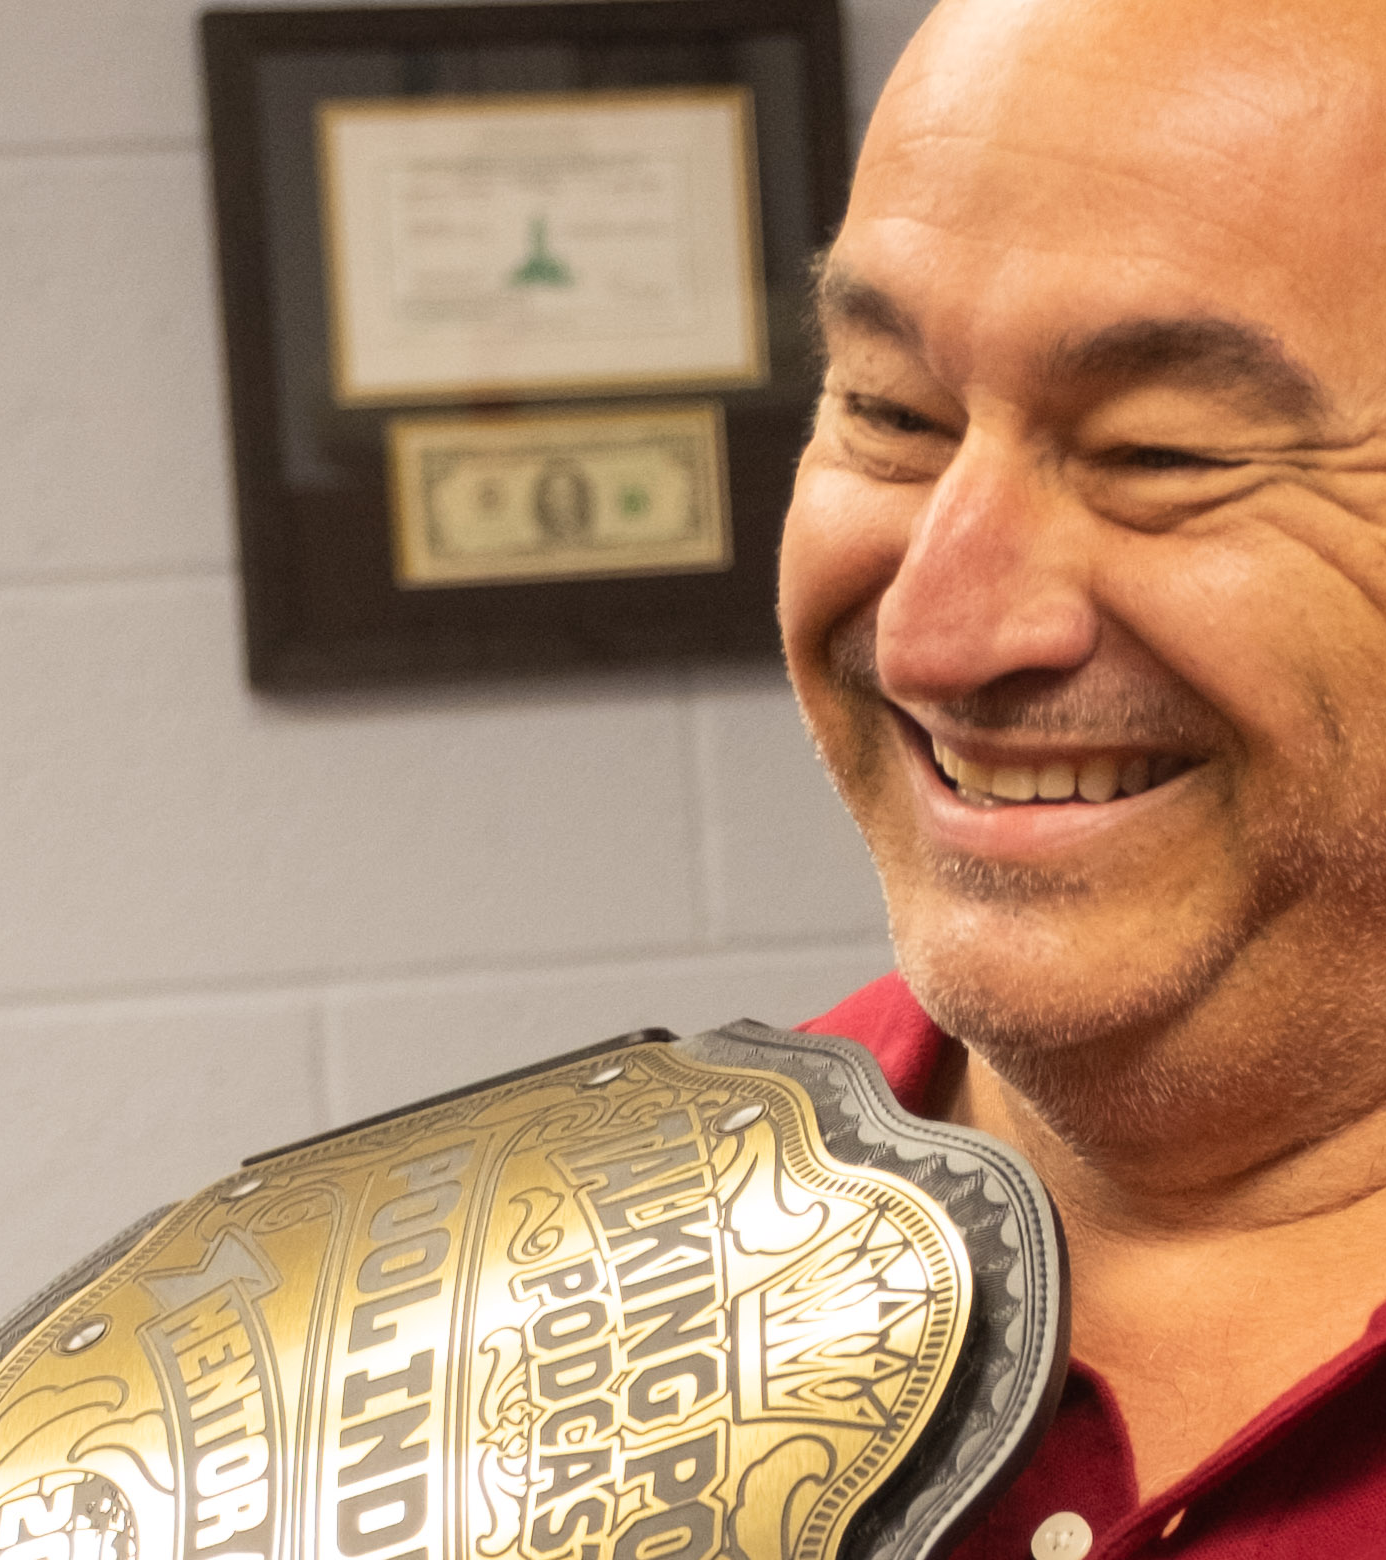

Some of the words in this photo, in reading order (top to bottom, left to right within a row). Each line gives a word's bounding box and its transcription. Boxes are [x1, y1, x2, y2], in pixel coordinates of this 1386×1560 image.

[348, 1139, 477, 1354] POOL
[549, 1104, 721, 1426] TALKING
[171, 1288, 270, 1552] MENTOR
